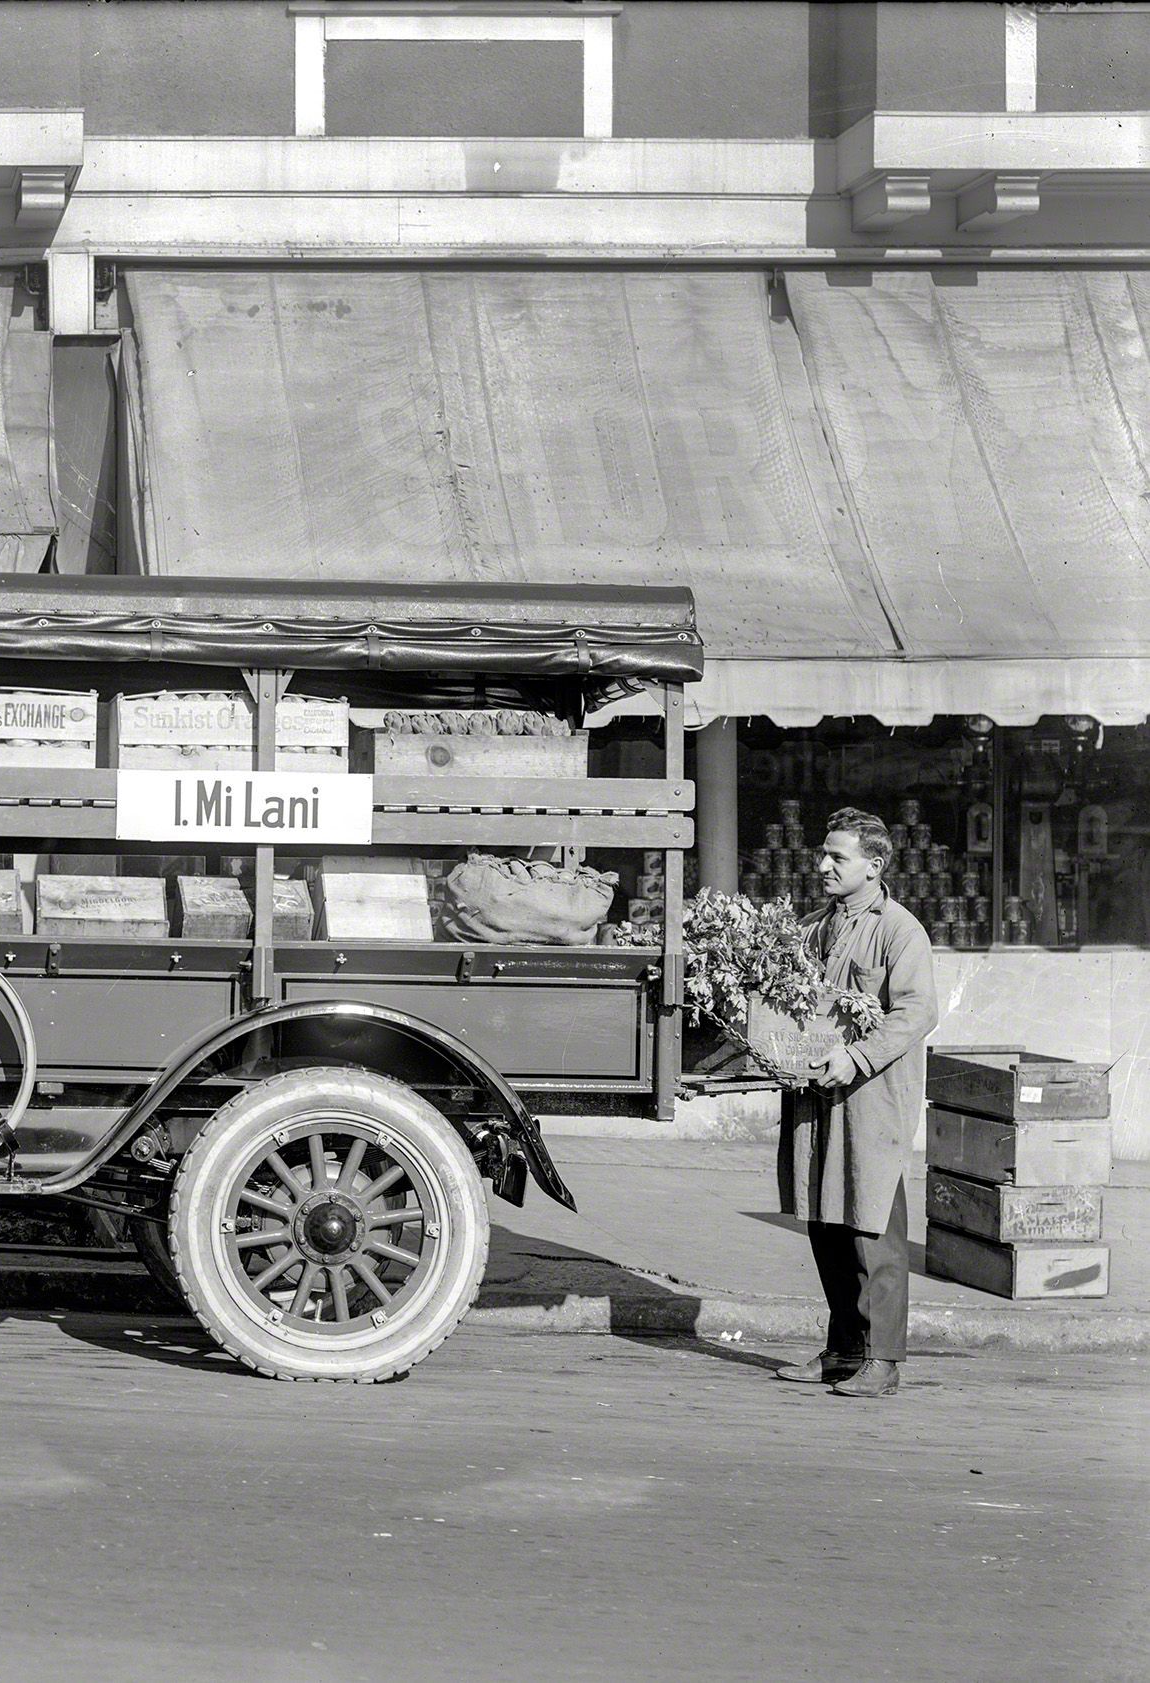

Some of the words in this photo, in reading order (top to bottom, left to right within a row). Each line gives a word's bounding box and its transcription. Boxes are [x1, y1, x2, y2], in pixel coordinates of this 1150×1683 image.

[4, 702, 66, 729] EXCHANGE
[133, 706, 213, 730] Sunkist
[217, 706, 305, 733] Oraes
[174, 779, 188, 826] I.
